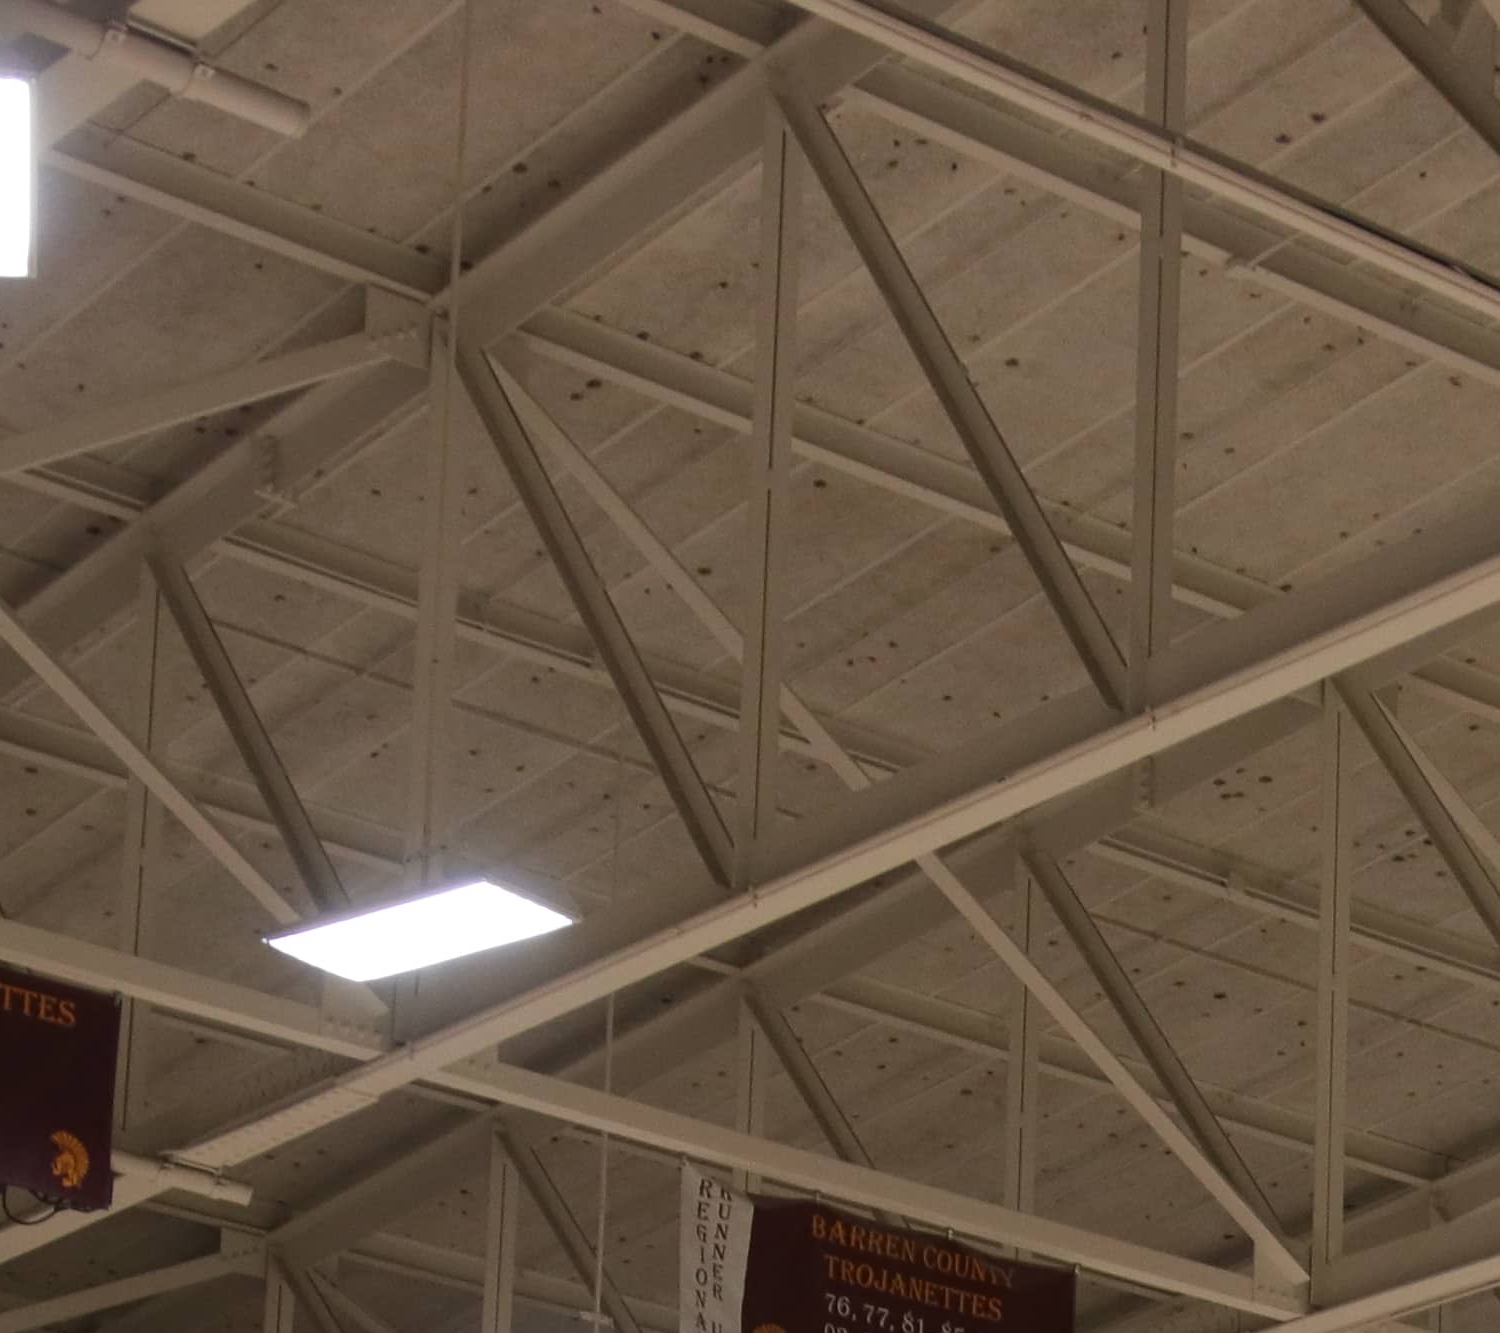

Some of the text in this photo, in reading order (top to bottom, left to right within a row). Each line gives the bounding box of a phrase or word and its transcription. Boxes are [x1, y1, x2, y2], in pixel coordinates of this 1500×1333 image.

[812, 1214, 1014, 1289] BARREN COUNTY
[823, 1254, 1003, 1321] TROJANETTES
[825, 1293, 858, 1322] 76,
[863, 1303, 895, 1332] 77,
